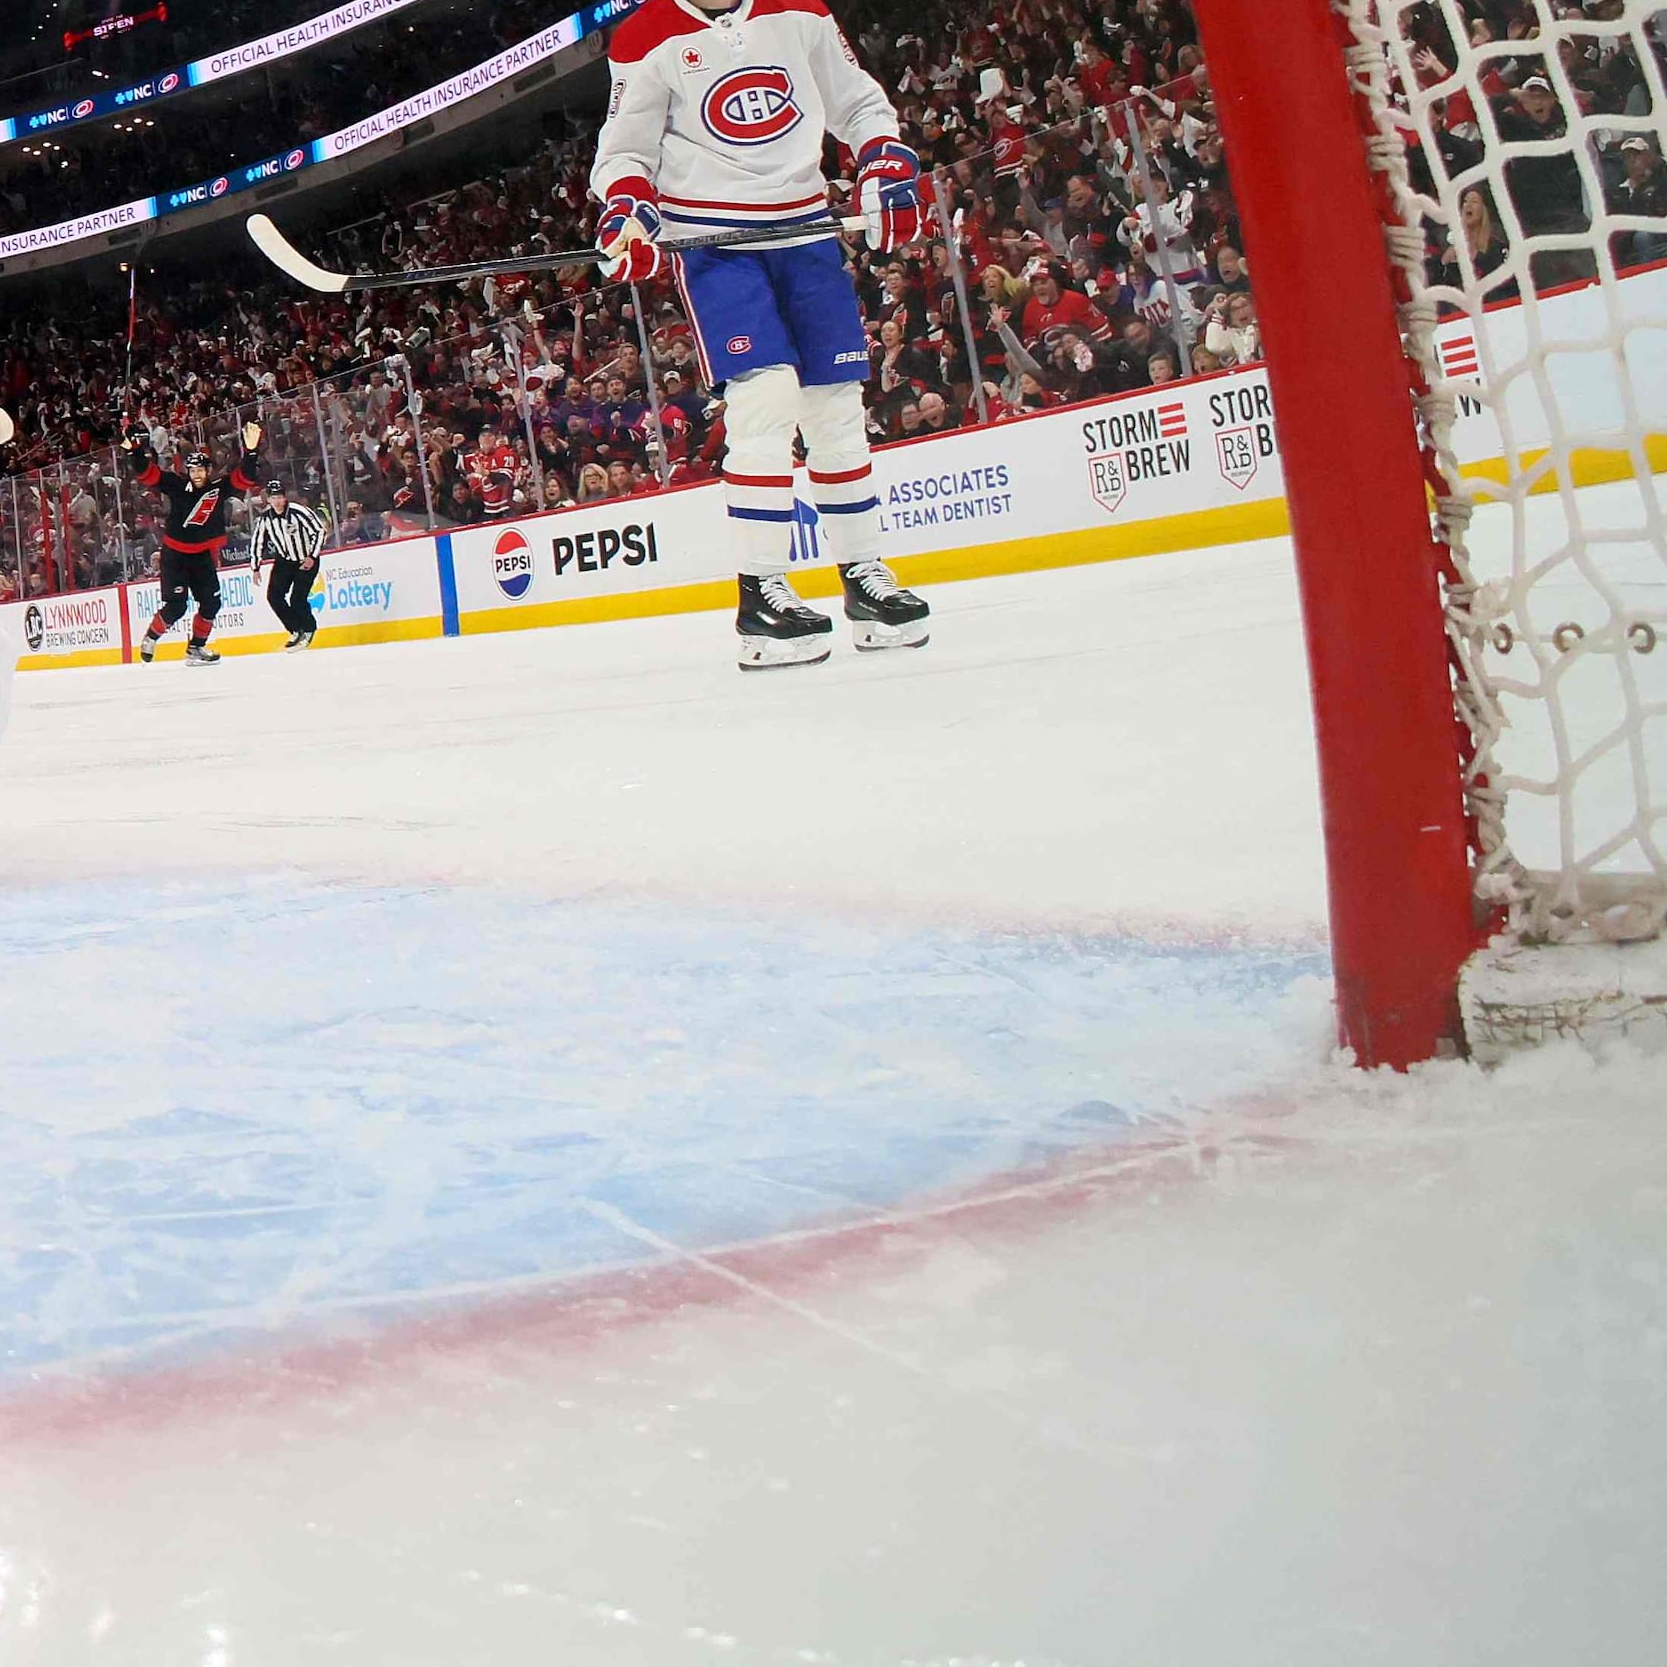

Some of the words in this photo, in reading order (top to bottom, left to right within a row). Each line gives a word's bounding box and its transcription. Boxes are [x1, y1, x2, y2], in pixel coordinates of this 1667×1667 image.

[211, 41, 274, 74] OFFICIAL
[276, 19, 329, 51] HEALTH
[334, 121, 385, 152] OFFICIAL
[386, 94, 432, 129] HEALTH
[434, 61, 504, 108] INSURANCE
[505, 29, 562, 73] PARTNER
[78, 207, 136, 235] PARTNER
[1083, 408, 1158, 453] STORM
[1127, 439, 1191, 482] BREW
[888, 464, 1009, 505] ASSOCIATES
[892, 501, 939, 532] TEAM
[942, 494, 1012, 523] DENTIST
[495, 555, 532, 573] PEPSI
[552, 522, 658, 576] PEPSI
[327, 569, 336, 580] NC
[337, 565, 373, 579] Education
[45, 597, 107, 625] LYNNWOOD
[325, 579, 392, 611] Lottery
[45, 629, 76, 648] BREWING
[77, 624, 110, 645] CONCERN
